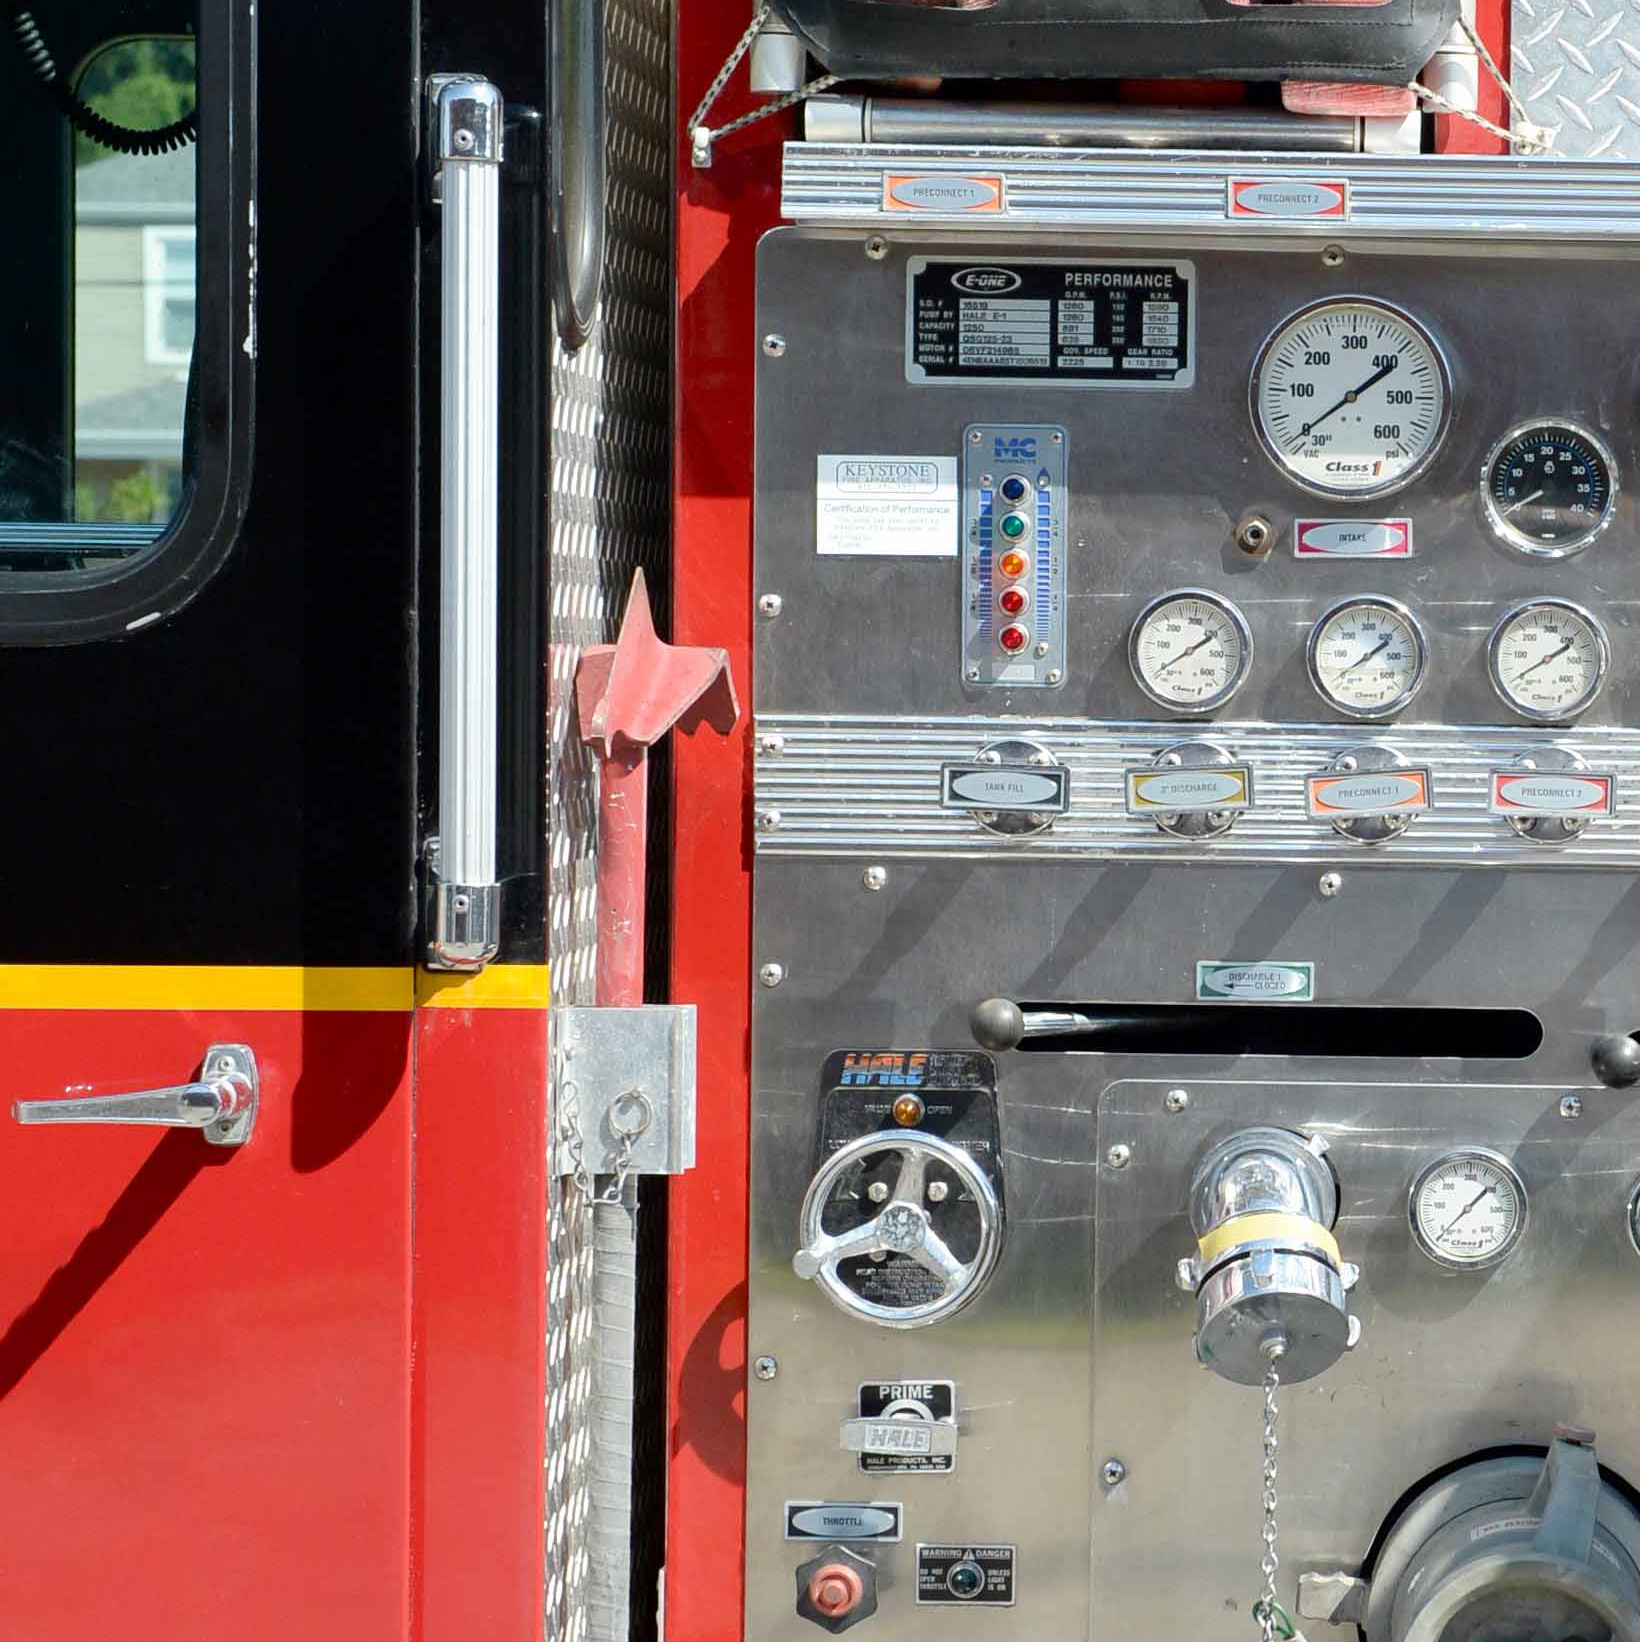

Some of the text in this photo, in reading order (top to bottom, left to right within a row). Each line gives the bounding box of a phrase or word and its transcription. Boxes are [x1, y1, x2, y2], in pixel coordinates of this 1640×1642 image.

[913, 186, 964, 198] PRECONNECT
[1256, 194, 1311, 204] PRECONNECT
[965, 275, 1006, 286] E-ONE
[1065, 273, 1173, 287] PERFORMANCE
[1341, 336, 1368, 350] 300
[1304, 352, 1330, 366] 200
[1372, 355, 1398, 369] 400
[1290, 383, 1314, 397] 100
[1386, 390, 1413, 404] 500
[1374, 425, 1400, 439] 600
[1540, 446, 1554, 455] 20
[1524, 454, 1534, 462] 15
[1559, 452, 1572, 461] 25
[846, 464, 929, 477] KEYSTONE
[1325, 461, 1369, 472] Class
[1572, 466, 1585, 475] 30
[1512, 469, 1523, 477] 10
[1508, 487, 1515, 496] 5
[1577, 484, 1590, 493] 35
[824, 504, 950, 514] Certification of Performance
[1571, 504, 1584, 513] 40
[1166, 624, 1181, 633] 200
[1361, 622, 1376, 632] 300
[1523, 633, 1537, 642] 200
[1157, 640, 1170, 649] 100
[1209, 649, 1224, 659] 500
[1386, 652, 1401, 661] 500
[1514, 651, 1527, 659] 100
[1566, 656, 1582, 665] 500
[1200, 668, 1216, 678] 600
[1558, 674, 1574, 684] 600
[984, 783, 1025, 793] TANK FILL
[1170, 782, 1218, 794] DISCHARGE
[1337, 787, 1393, 799] PRECONNECT
[1521, 787, 1575, 797] PRECONNECT
[1228, 973, 1276, 981] DISCHARGE
[1255, 982, 1287, 990] CLOSED
[841, 1053, 928, 1085] HALE
[879, 1386, 934, 1399] PRIME
[869, 1428, 929, 1448] HALE
[823, 1517, 864, 1526] THROTTLE
[922, 1549, 962, 1557] WARNING
